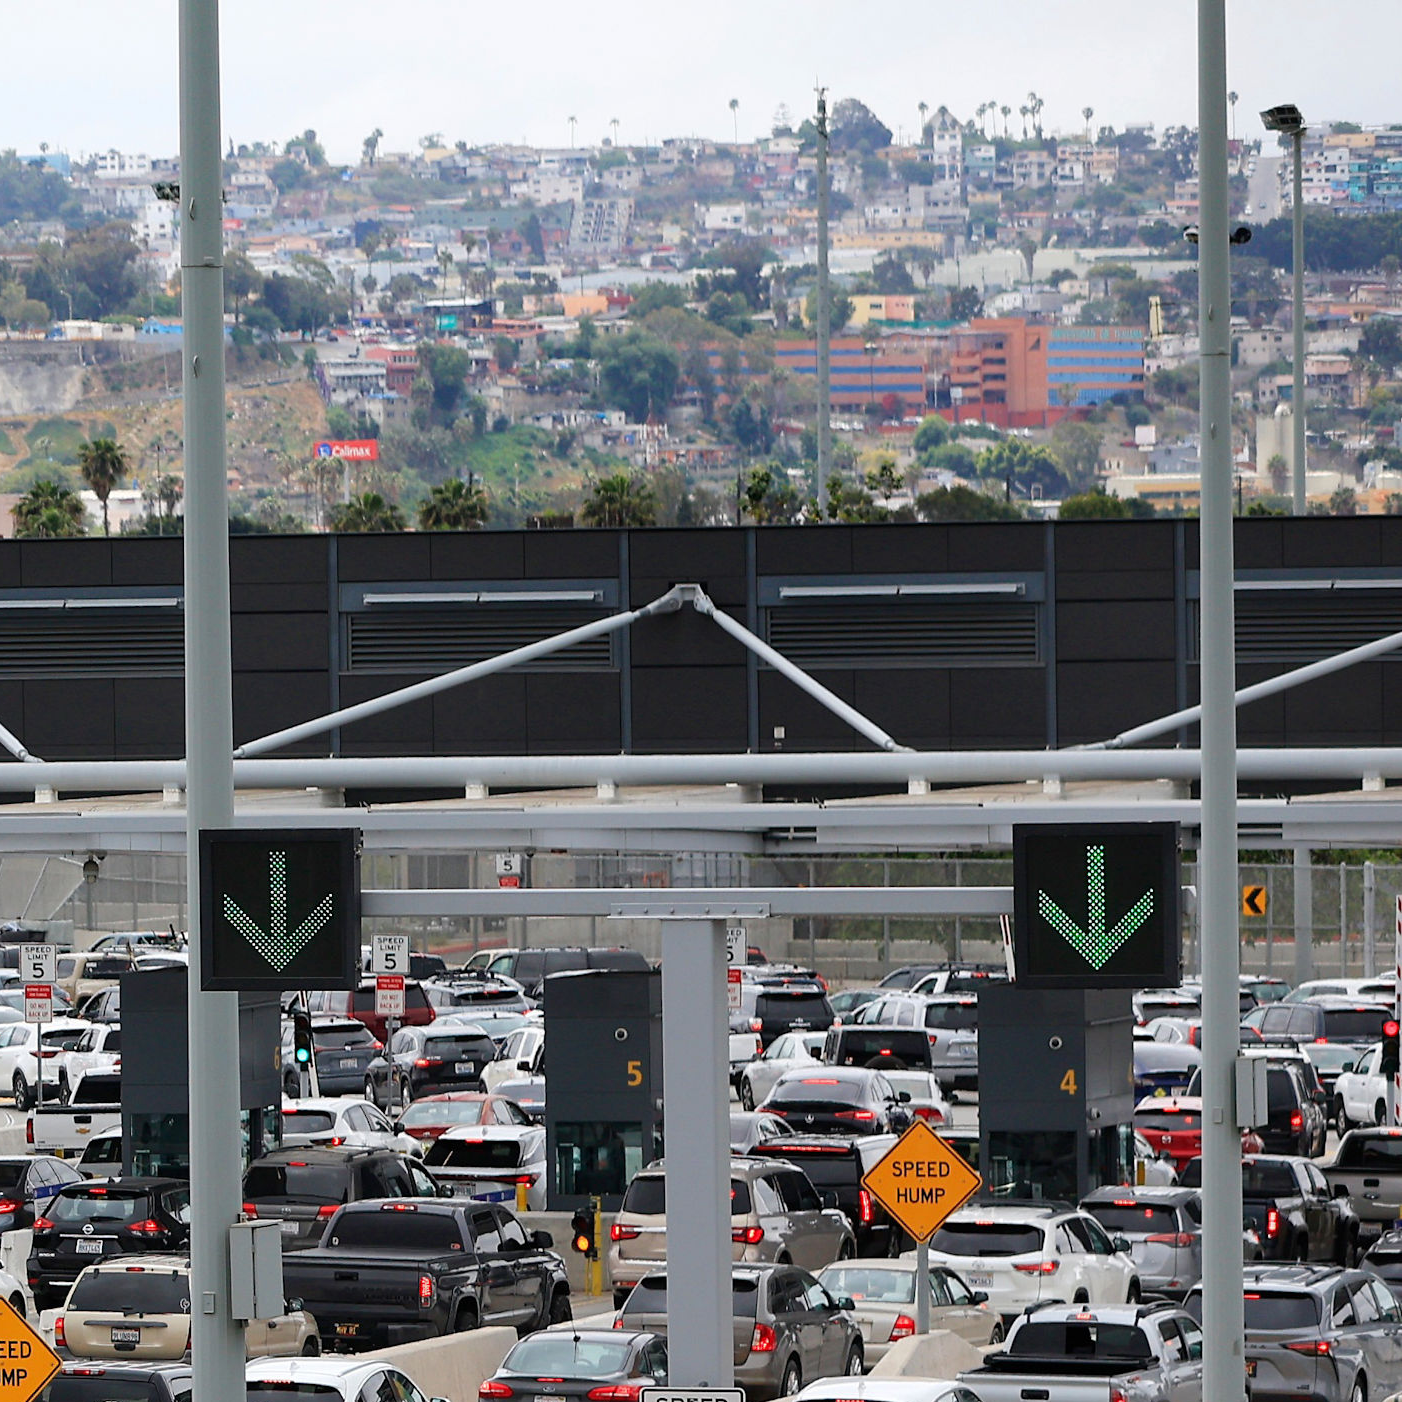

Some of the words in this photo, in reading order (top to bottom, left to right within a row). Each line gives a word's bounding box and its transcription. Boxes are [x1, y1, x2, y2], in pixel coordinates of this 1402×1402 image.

[332, 443, 371, 458] Calimax
[379, 944, 402, 952] LIMIT
[32, 962, 45, 978] 5
[383, 954, 397, 970] 5
[627, 1060, 643, 1087] 5
[1059, 1069, 1078, 1095] 4
[892, 1161, 950, 1178] SPEED
[897, 1188, 946, 1204] HUMP
